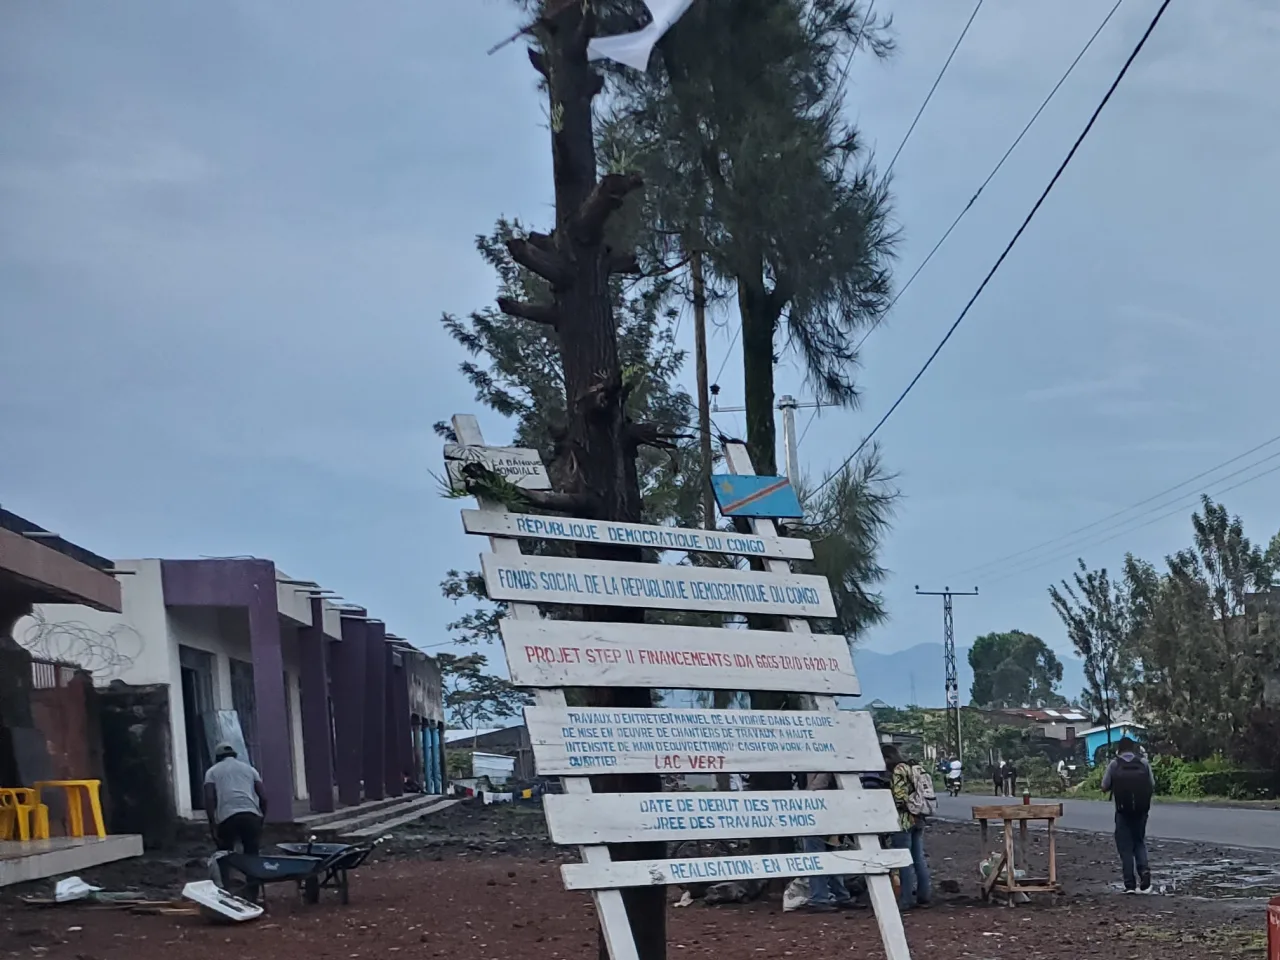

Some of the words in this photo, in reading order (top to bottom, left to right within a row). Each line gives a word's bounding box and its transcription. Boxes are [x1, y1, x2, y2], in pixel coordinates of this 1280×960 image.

[607, 526, 702, 548] DEMOCRATIQUE
[705, 536, 722, 551] DU
[726, 538, 766, 553] CONGO
[498, 568, 538, 590] FONDS
[540, 571, 583, 593] SOCIAL
[584, 574, 602, 594] DE
[602, 575, 619, 596] LA
[620, 577, 687, 599] REPUBLIQUE
[690, 581, 769, 603] DEMOCRATIQUE
[769, 585, 785, 603] DU
[786, 586, 820, 605] CONGO
[524, 645, 580, 664] PROJET
[585, 648, 622, 664] STEP
[638, 649, 732, 668] FINANCEMENTS
[734, 654, 754, 669] IDA
[567, 713, 612, 724] TRAVAUX
[675, 713, 710, 725] MANUEL
[711, 714, 724, 725] DE
[724, 714, 738, 725] LA
[740, 714, 767, 725] VOIRIE
[768, 715, 791, 726] DANS
[792, 715, 803, 726] LE
[805, 716, 834, 727] CADRE
[562, 727, 576, 738] DE
[600, 728, 613, 738] EN
[656, 728, 670, 738] DE
[671, 727, 720, 738] CHANTIERS
[721, 728, 734, 738] DE
[735, 728, 776, 739] TRAVAUX
[780, 729, 785, 739] A
[786, 729, 815, 739] HAUTE
[565, 742, 616, 752] INTENSITE
[617, 742, 630, 752] DE
[633, 741, 655, 752] MAIN
[813, 742, 836, 752] GOMA
[569, 756, 618, 767] QUARTIER
[655, 754, 681, 769] LAC
[688, 755, 726, 769] VERT
[640, 799, 675, 813] DATE
[677, 798, 695, 812] DE
[700, 798, 739, 812] DEBUT
[744, 798, 770, 812] DES
[772, 798, 827, 811] TRAVAUX
[689, 816, 715, 829] DES
[789, 814, 816, 827] MOIS
[761, 858, 781, 873] EN
[787, 856, 824, 872] REGIE
